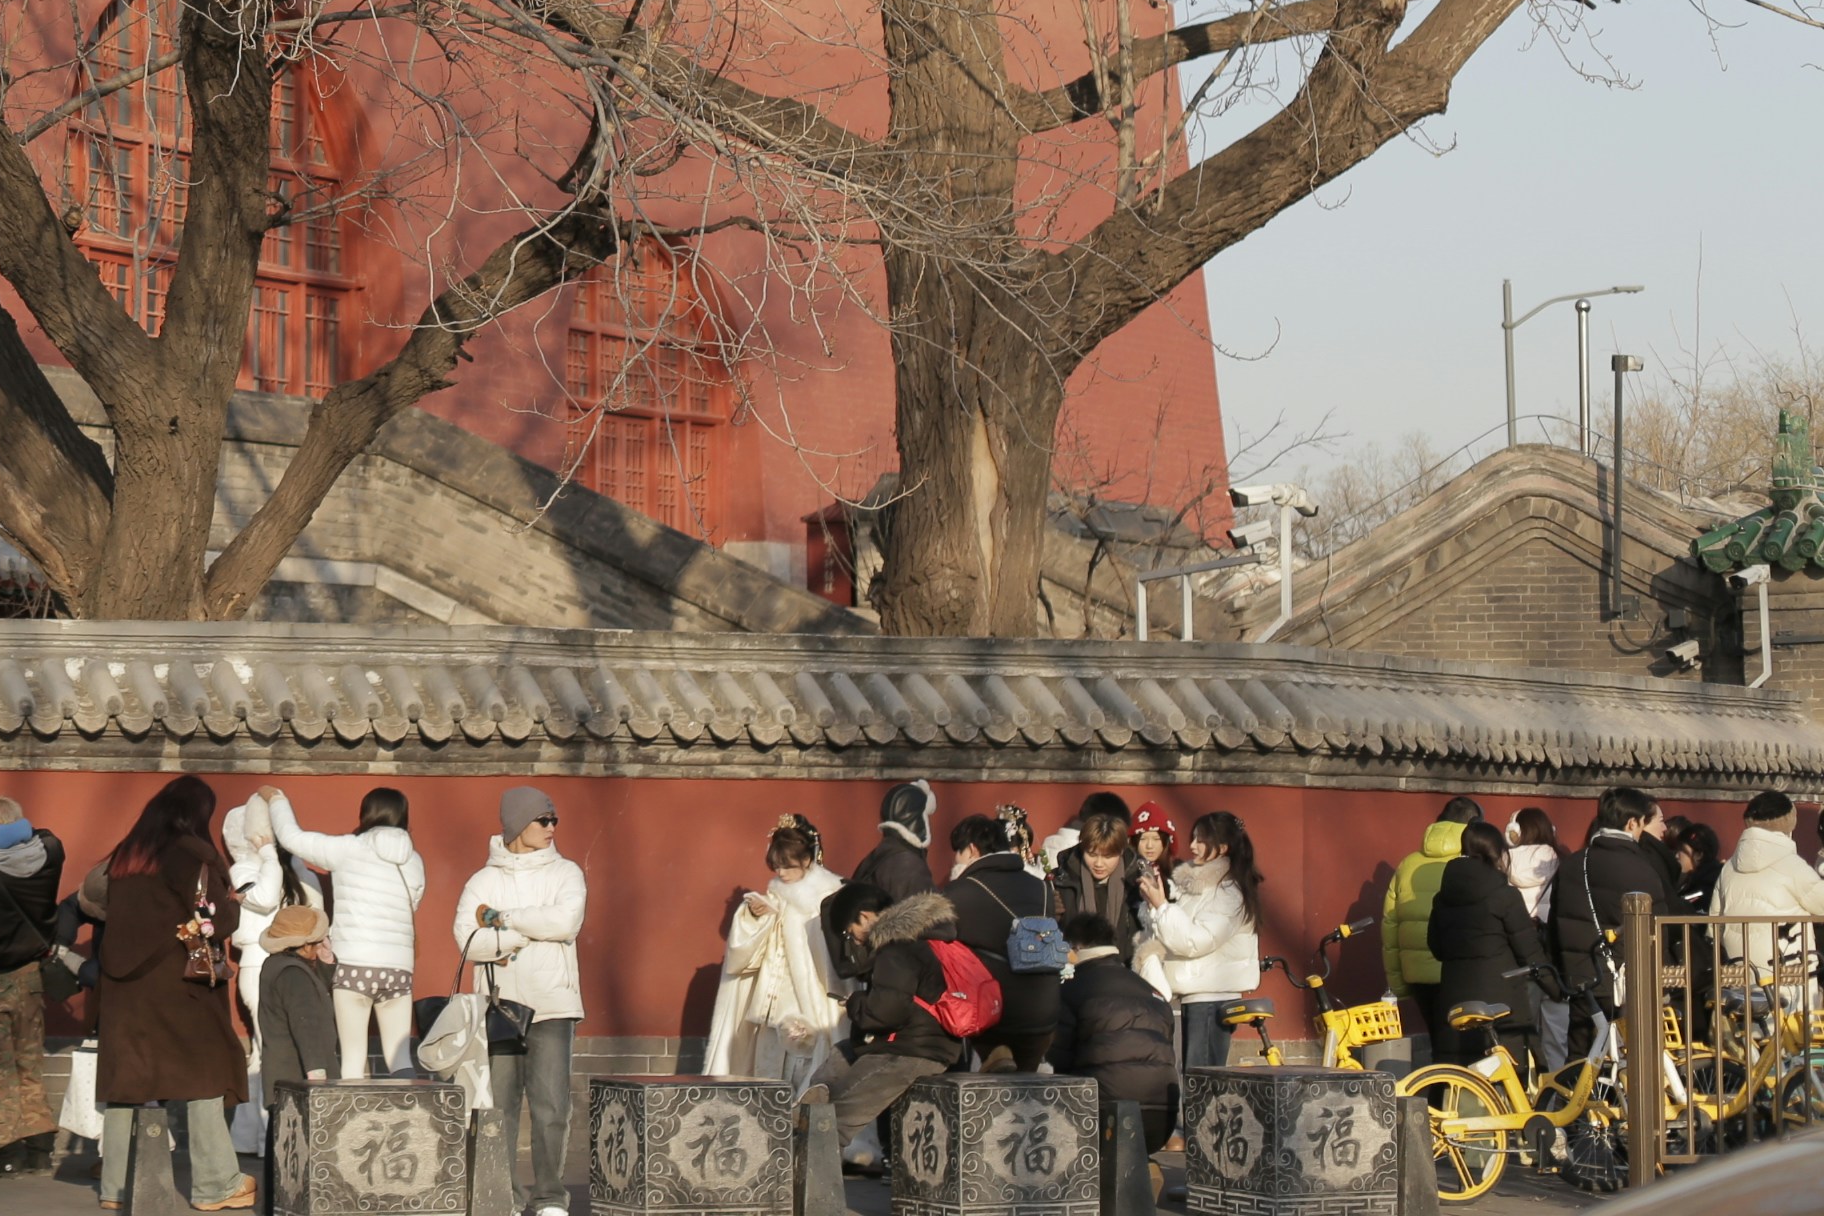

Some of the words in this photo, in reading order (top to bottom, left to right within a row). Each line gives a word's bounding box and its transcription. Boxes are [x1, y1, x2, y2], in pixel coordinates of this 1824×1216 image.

[283, 1117, 299, 1184] 福
[351, 1120, 419, 1187] 福
[604, 1114, 629, 1179] 福
[685, 1114, 748, 1181] 福
[908, 1110, 939, 1176] 福
[997, 1111, 1057, 1177] 福
[1209, 1103, 1249, 1173] 福
[1306, 1105, 1361, 1173] 福
